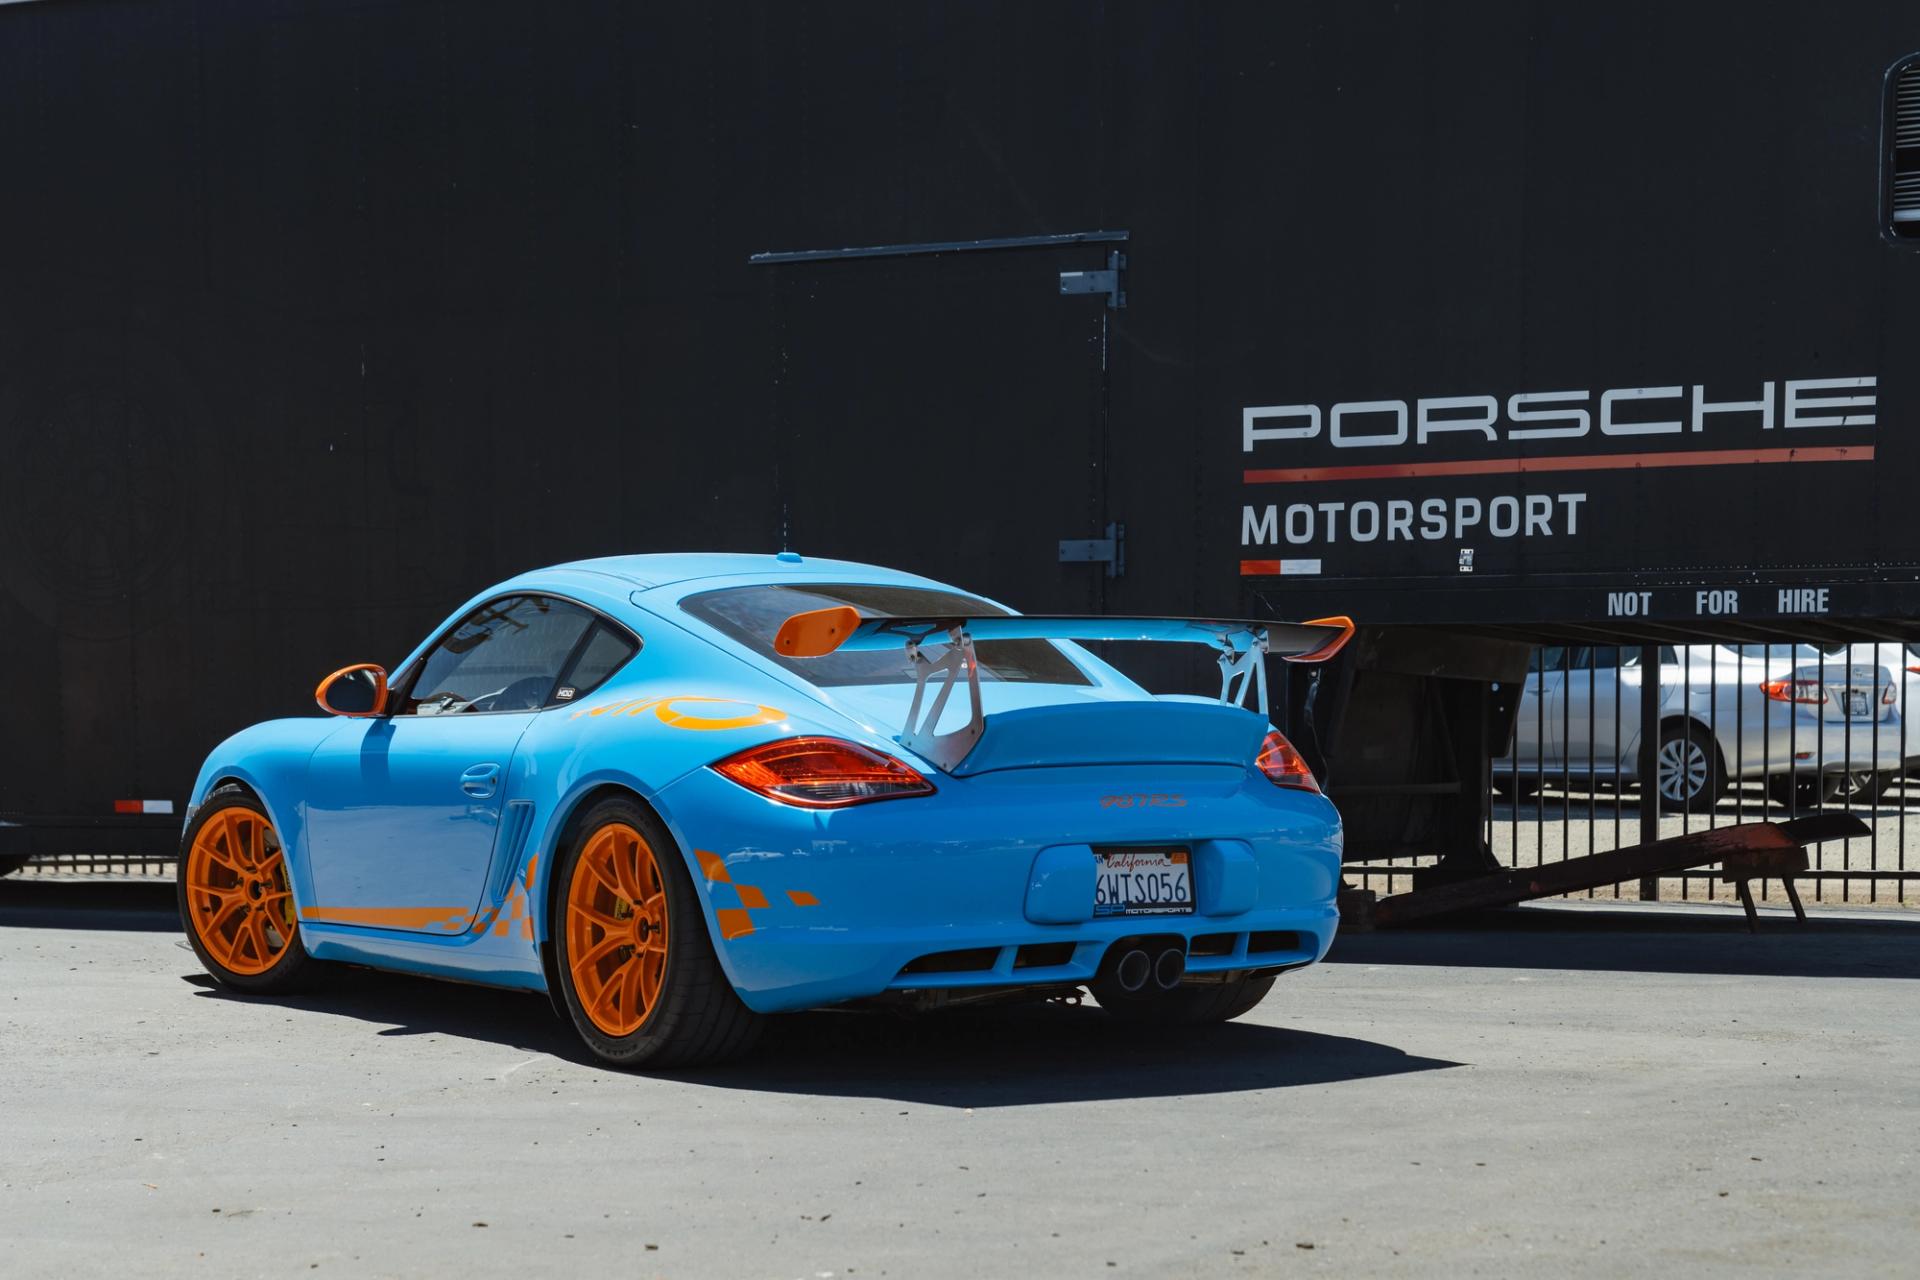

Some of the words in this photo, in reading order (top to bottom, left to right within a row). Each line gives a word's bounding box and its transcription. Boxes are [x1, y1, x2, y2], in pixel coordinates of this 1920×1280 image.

[1243, 376, 1877, 452] PORSCHE
[1241, 492, 1587, 545] MOTORSPORT
[1607, 592, 1652, 616] NOT
[1696, 590, 1738, 615] FOR
[1777, 588, 1829, 613] HIRE
[1106, 851, 1171, 872] California
[1125, 907, 1193, 915] MOTOORT
